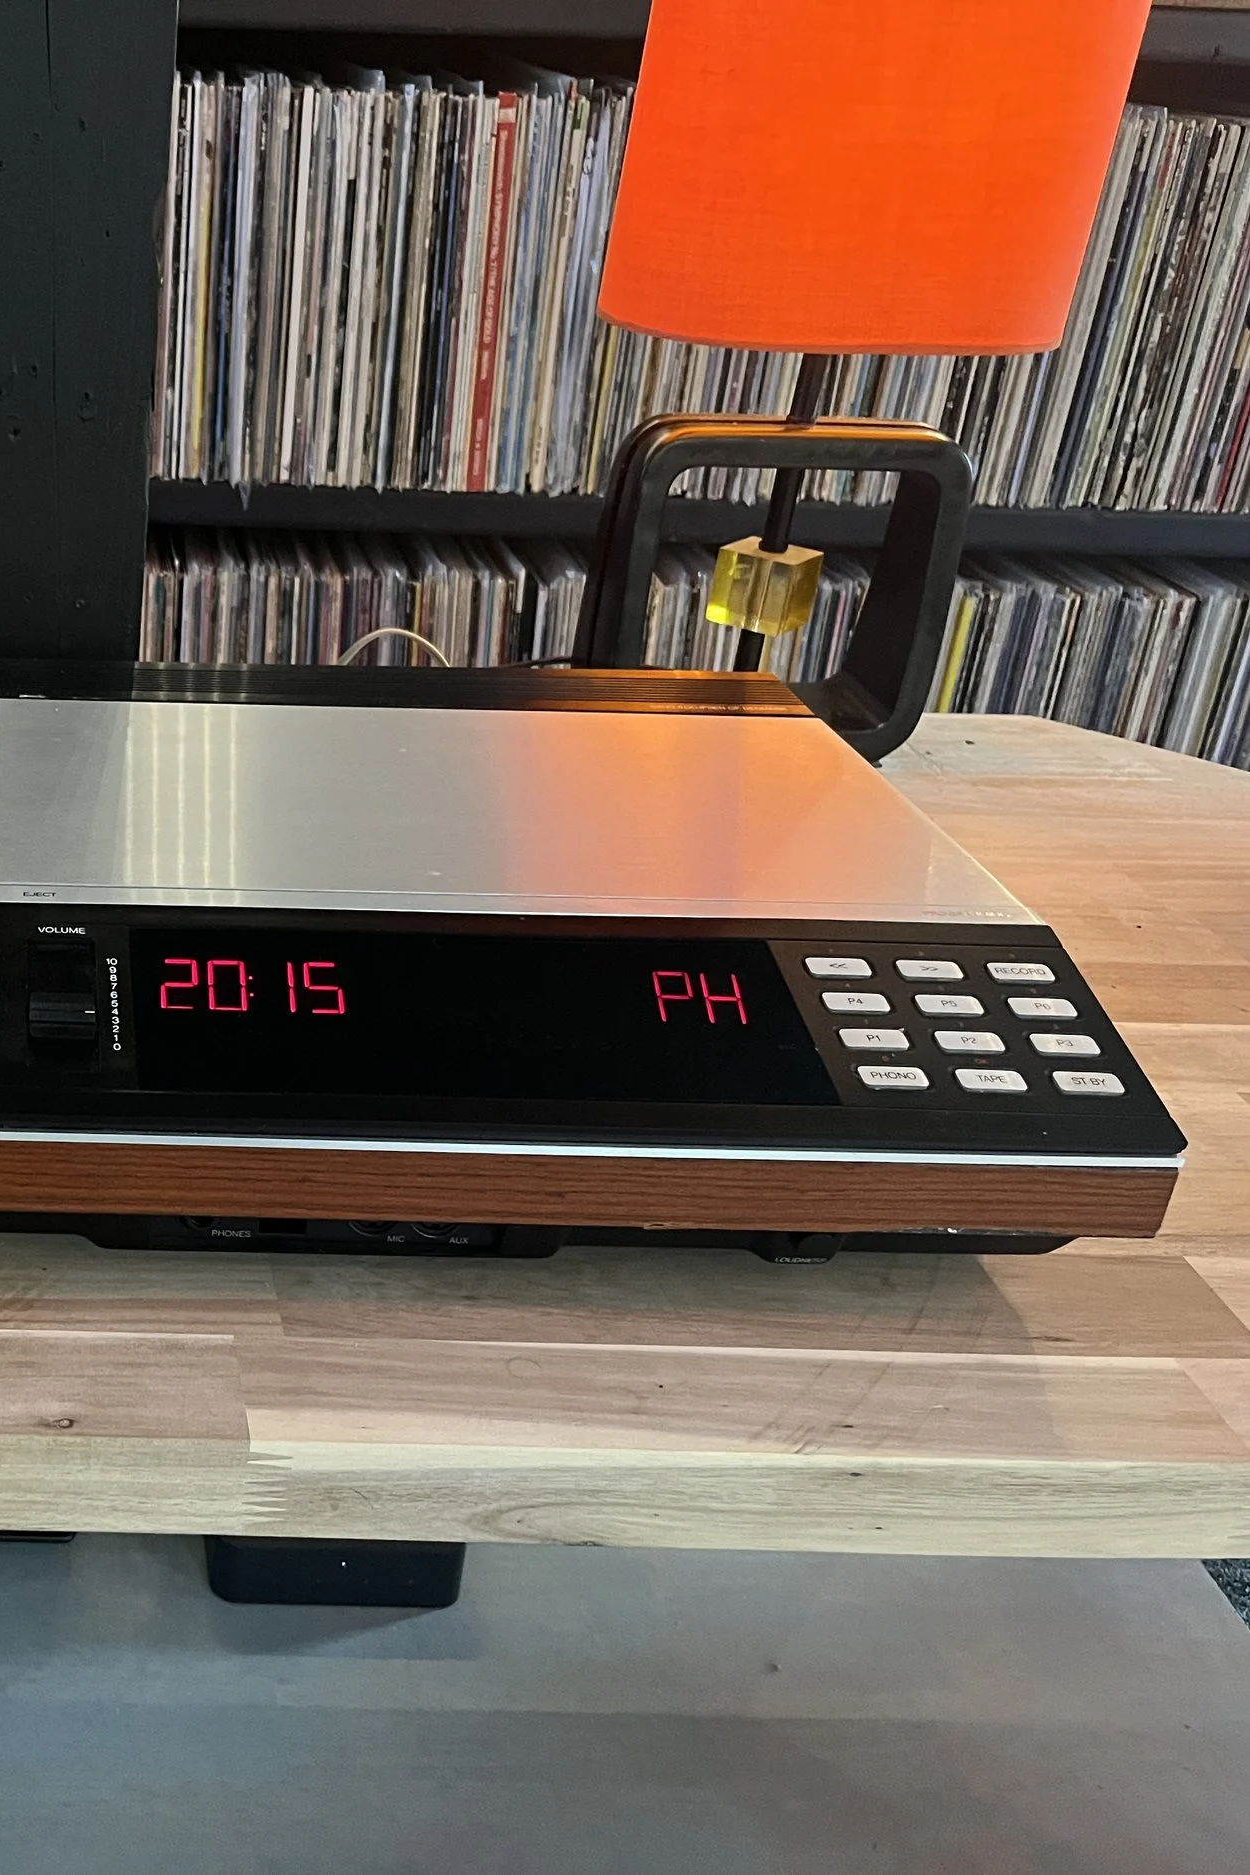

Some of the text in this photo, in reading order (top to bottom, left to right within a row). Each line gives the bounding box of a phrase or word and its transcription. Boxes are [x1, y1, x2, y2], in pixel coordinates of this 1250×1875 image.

[37, 926, 86, 935] VOLUME
[106, 957, 118, 966] 10
[109, 966, 117, 974] 9
[993, 967, 1046, 975] RECORD
[110, 974, 117, 982] 8
[110, 991, 118, 999] 6
[652, 971, 747, 1025] PH
[847, 997, 863, 1005] P4
[941, 1000, 958, 1008] P5
[111, 1016, 120, 1024] 3
[112, 1025, 120, 1033] 2
[866, 1034, 882, 1042] P1
[960, 1036, 977, 1044] P2
[113, 1043, 121, 1051] 0
[1055, 1039, 1074, 1047] P3
[870, 1071, 917, 1080] PHONO
[976, 1074, 1009, 1083] TAPE
[211, 1229, 252, 1238] PHONES
[387, 1235, 406, 1243] MIC
